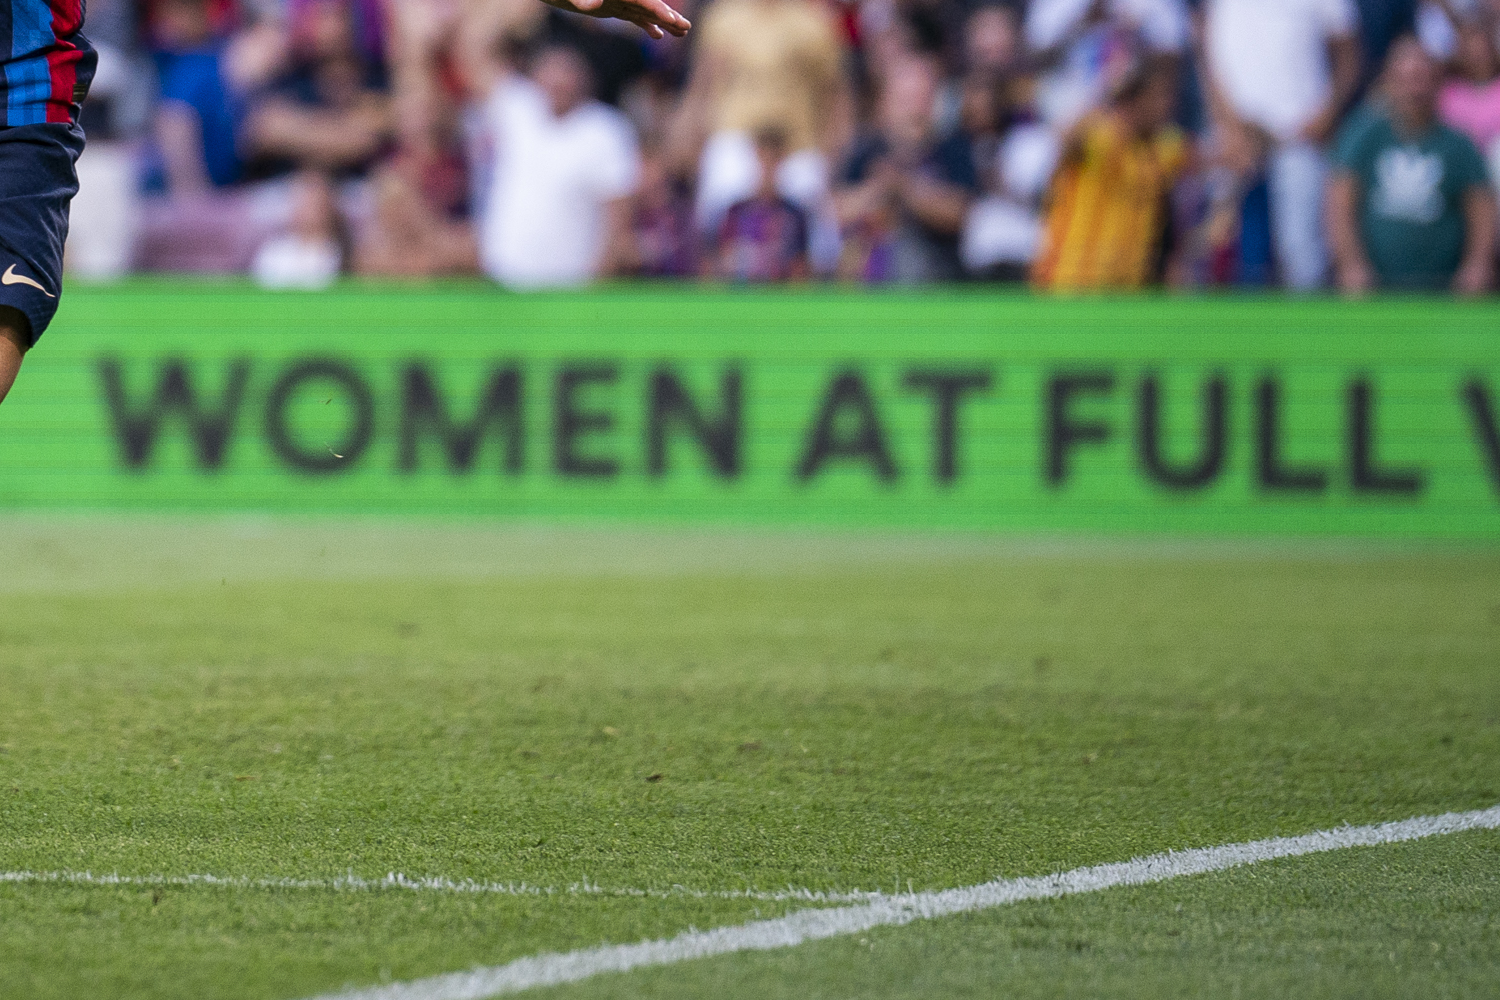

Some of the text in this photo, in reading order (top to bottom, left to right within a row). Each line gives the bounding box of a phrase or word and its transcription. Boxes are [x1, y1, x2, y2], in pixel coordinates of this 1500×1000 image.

[94, 355, 746, 479] WOMEN
[795, 361, 994, 488] AT
[1044, 362, 1427, 495] FULL
